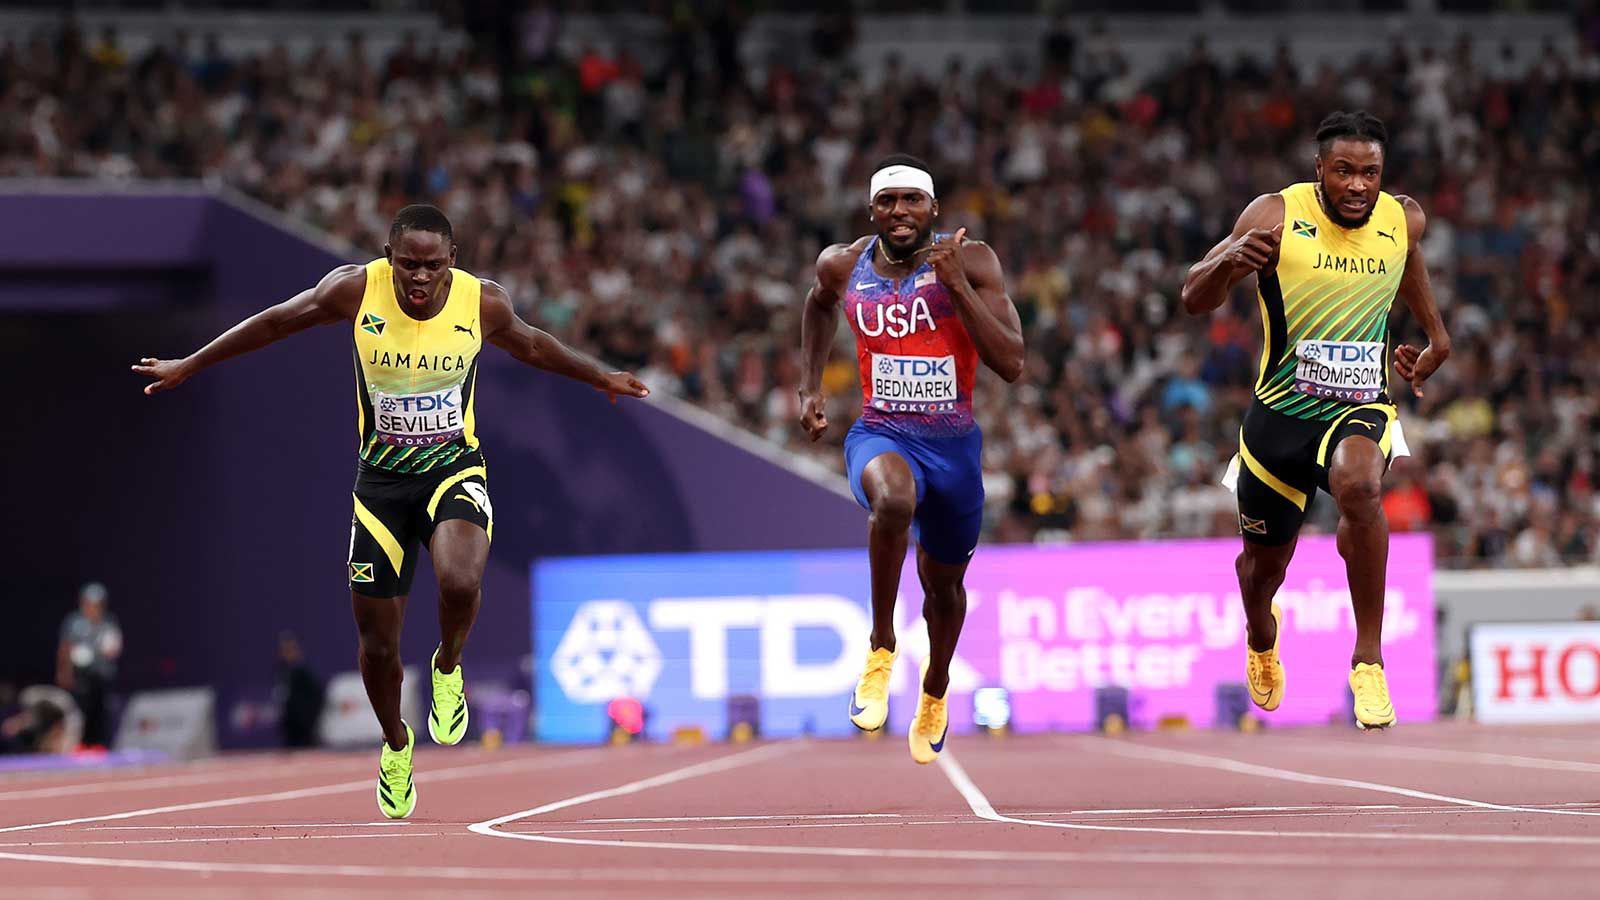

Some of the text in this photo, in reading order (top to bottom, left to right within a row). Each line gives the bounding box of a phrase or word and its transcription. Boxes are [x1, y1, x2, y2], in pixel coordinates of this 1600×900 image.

[1312, 252, 1387, 275] JAMAICA
[856, 296, 937, 338] USA
[369, 349, 465, 371] JAMAICA
[1321, 343, 1378, 363] TDK
[893, 358, 950, 377] TDK
[1301, 359, 1379, 386] THOMPSON
[875, 378, 953, 399] BEDNAREK
[396, 390, 456, 413] TDK
[379, 409, 459, 433] SEVILLE
[998, 588, 1056, 641] In
[648, 592, 986, 700] TDK
[1002, 640, 1203, 693] Better
